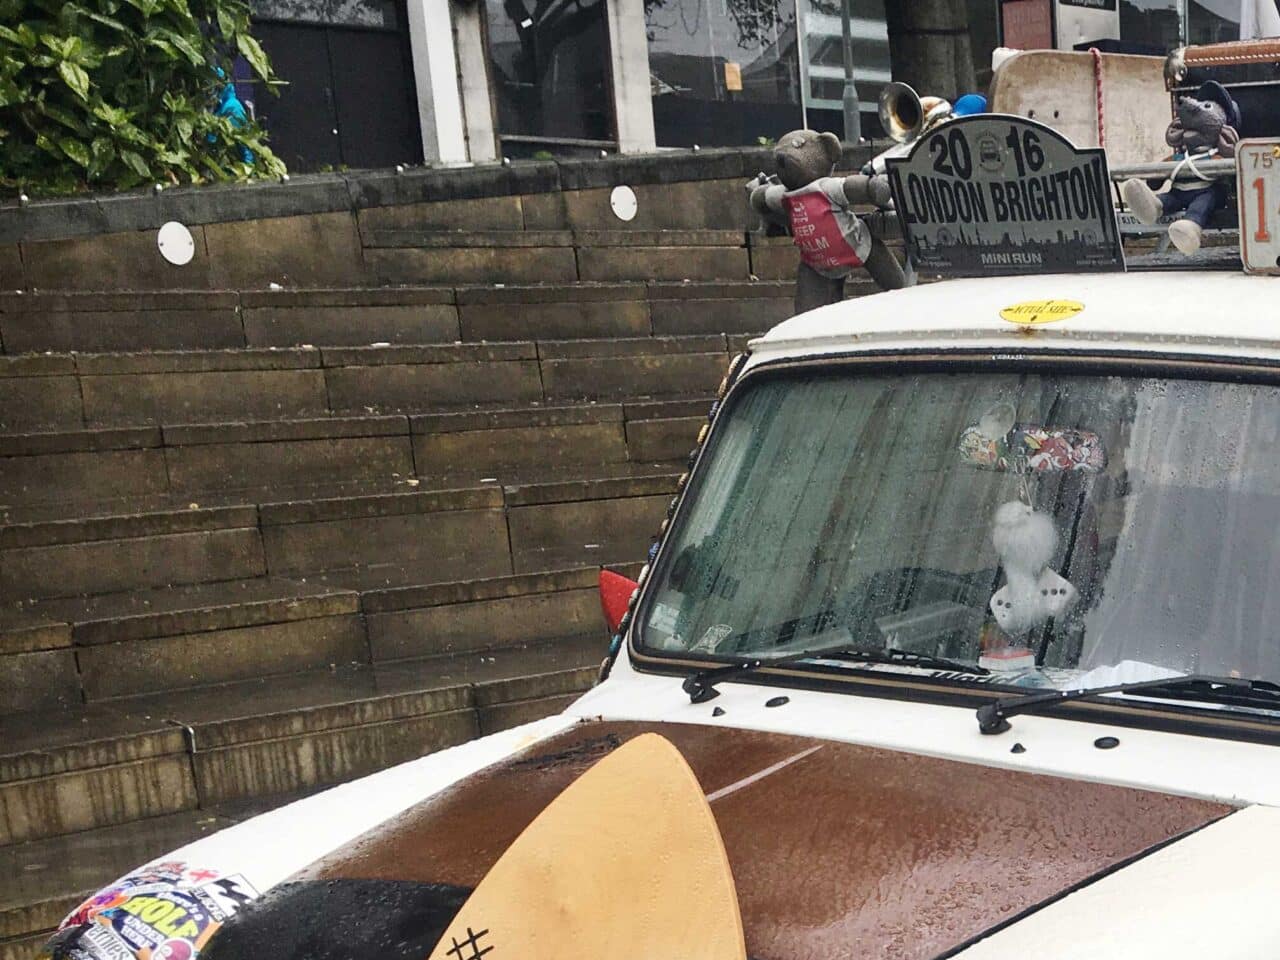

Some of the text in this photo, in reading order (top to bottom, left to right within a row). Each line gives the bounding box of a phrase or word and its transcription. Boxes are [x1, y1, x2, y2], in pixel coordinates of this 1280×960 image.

[929, 126, 1045, 180] 20 16
[888, 156, 1107, 225] LONDON BRIGHTON
[1011, 252, 1043, 265] RUN
